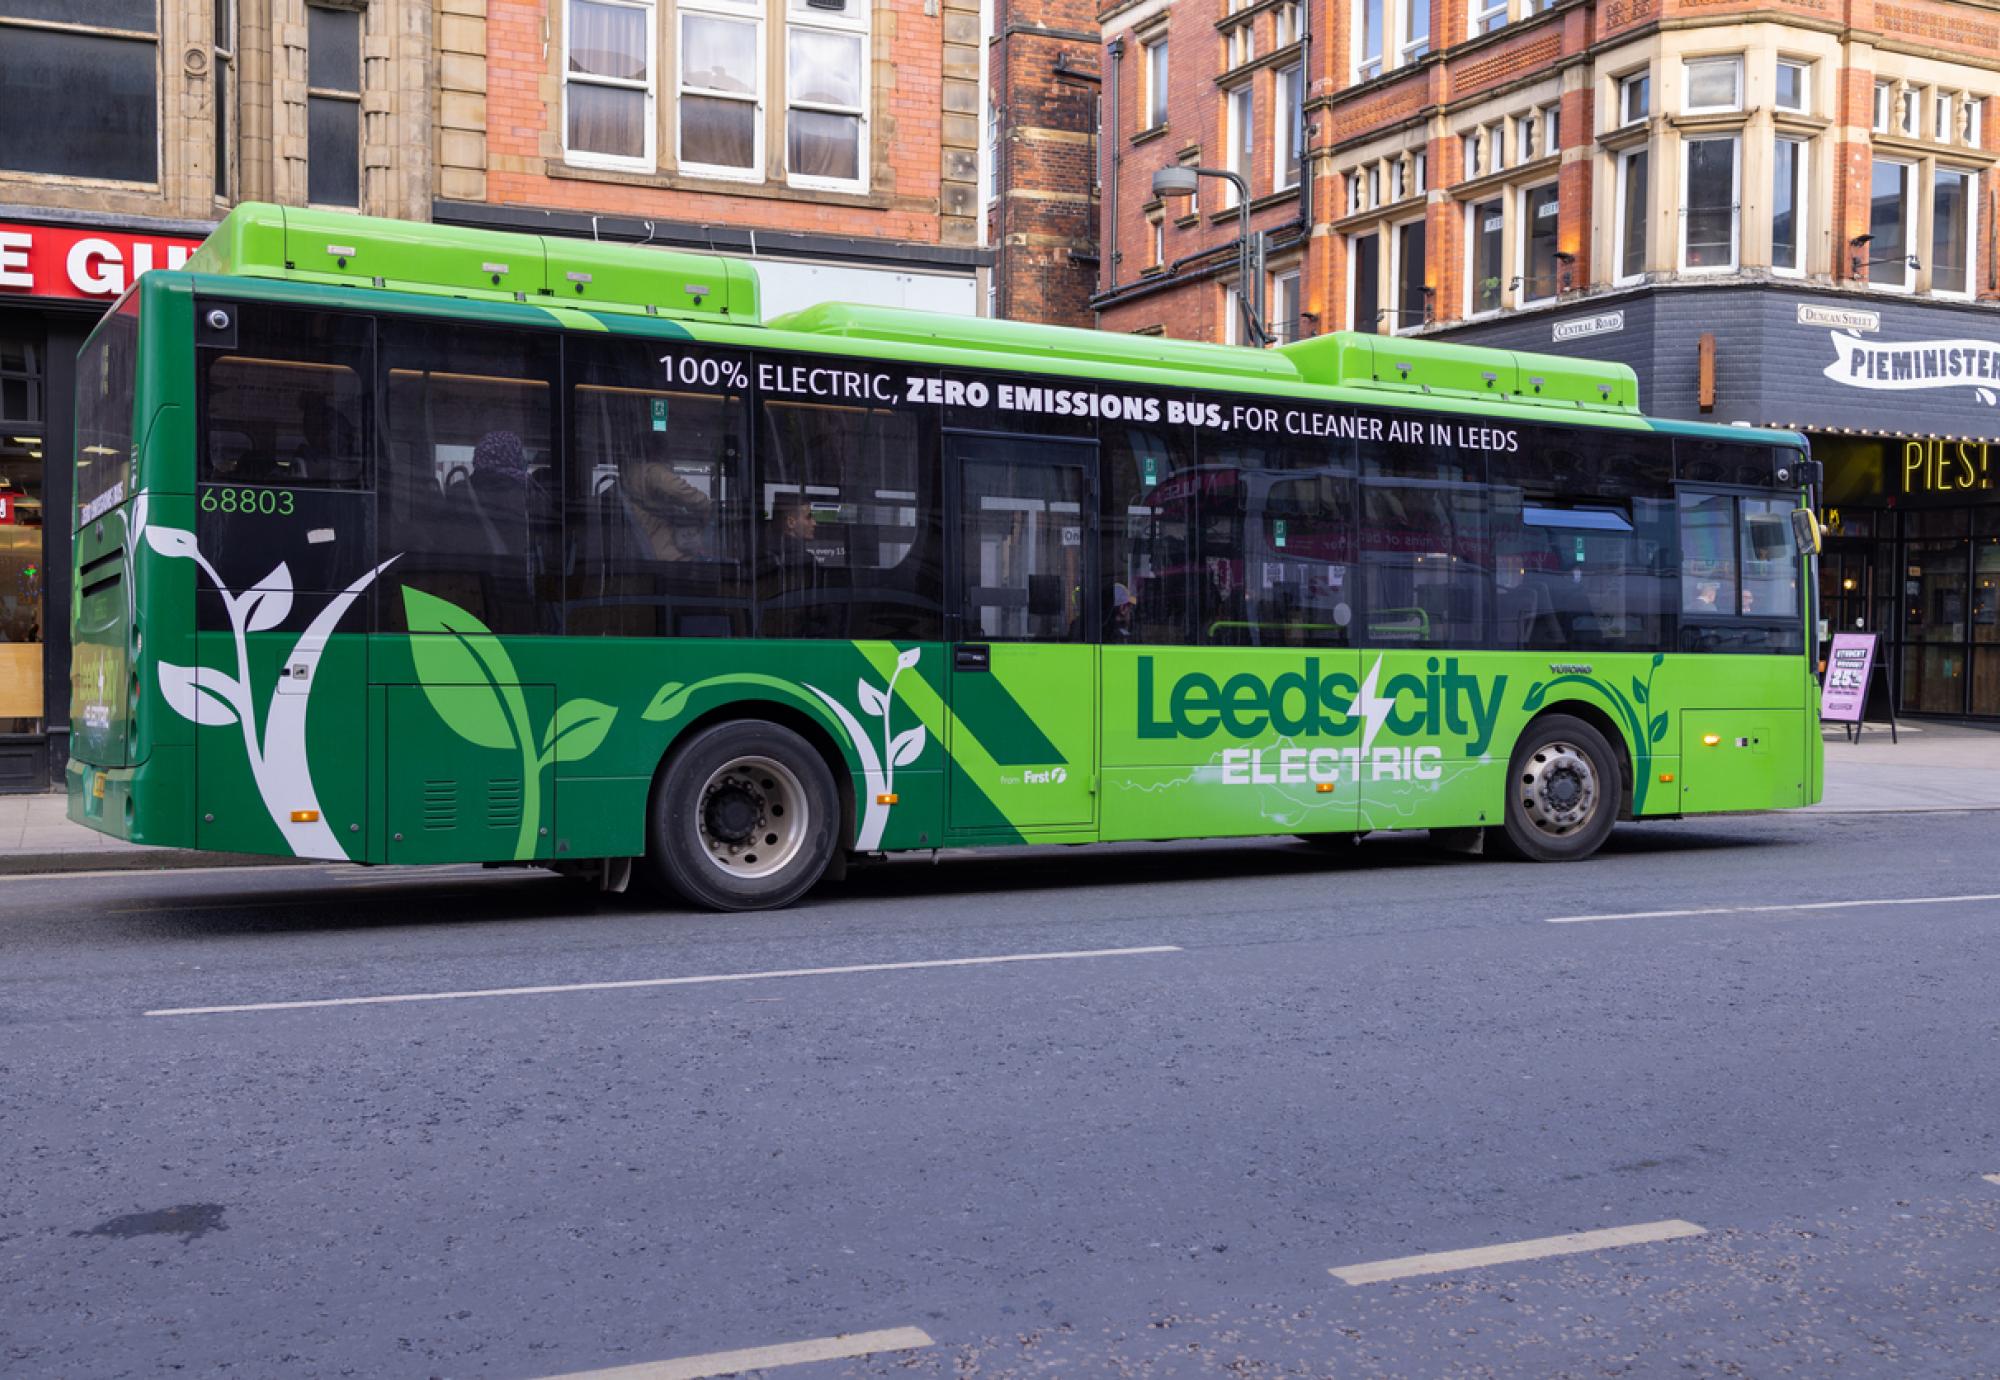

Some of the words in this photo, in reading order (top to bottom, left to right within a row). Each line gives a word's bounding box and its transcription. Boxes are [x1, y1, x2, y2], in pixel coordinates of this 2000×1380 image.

[67, 238, 198, 295] GU
[1557, 321, 1593, 336] CENTRAL
[1596, 317, 1618, 329] ROAD
[1805, 308, 1841, 323] DUNCAN
[1842, 312, 1873, 327] STREET
[658, 354, 749, 389] 100%
[758, 363, 899, 405] ELECTRIC,
[906, 376, 990, 408] ZERO
[998, 384, 1160, 422] EMISSIONS
[1167, 400, 1232, 432] BUS,
[1232, 405, 1279, 432] FOR
[1285, 410, 1383, 441] CLEANER
[1388, 420, 1424, 444] AIR
[1429, 423, 1451, 446] IN
[1458, 425, 1519, 452] LEEDS
[1904, 440, 1988, 493] PIES!
[200, 487, 295, 516] 68803
[1137, 655, 1364, 739] Leeds
[1382, 656, 1508, 757] city
[1023, 769, 1050, 784] First
[1221, 745, 1443, 785] ELECTRIC
